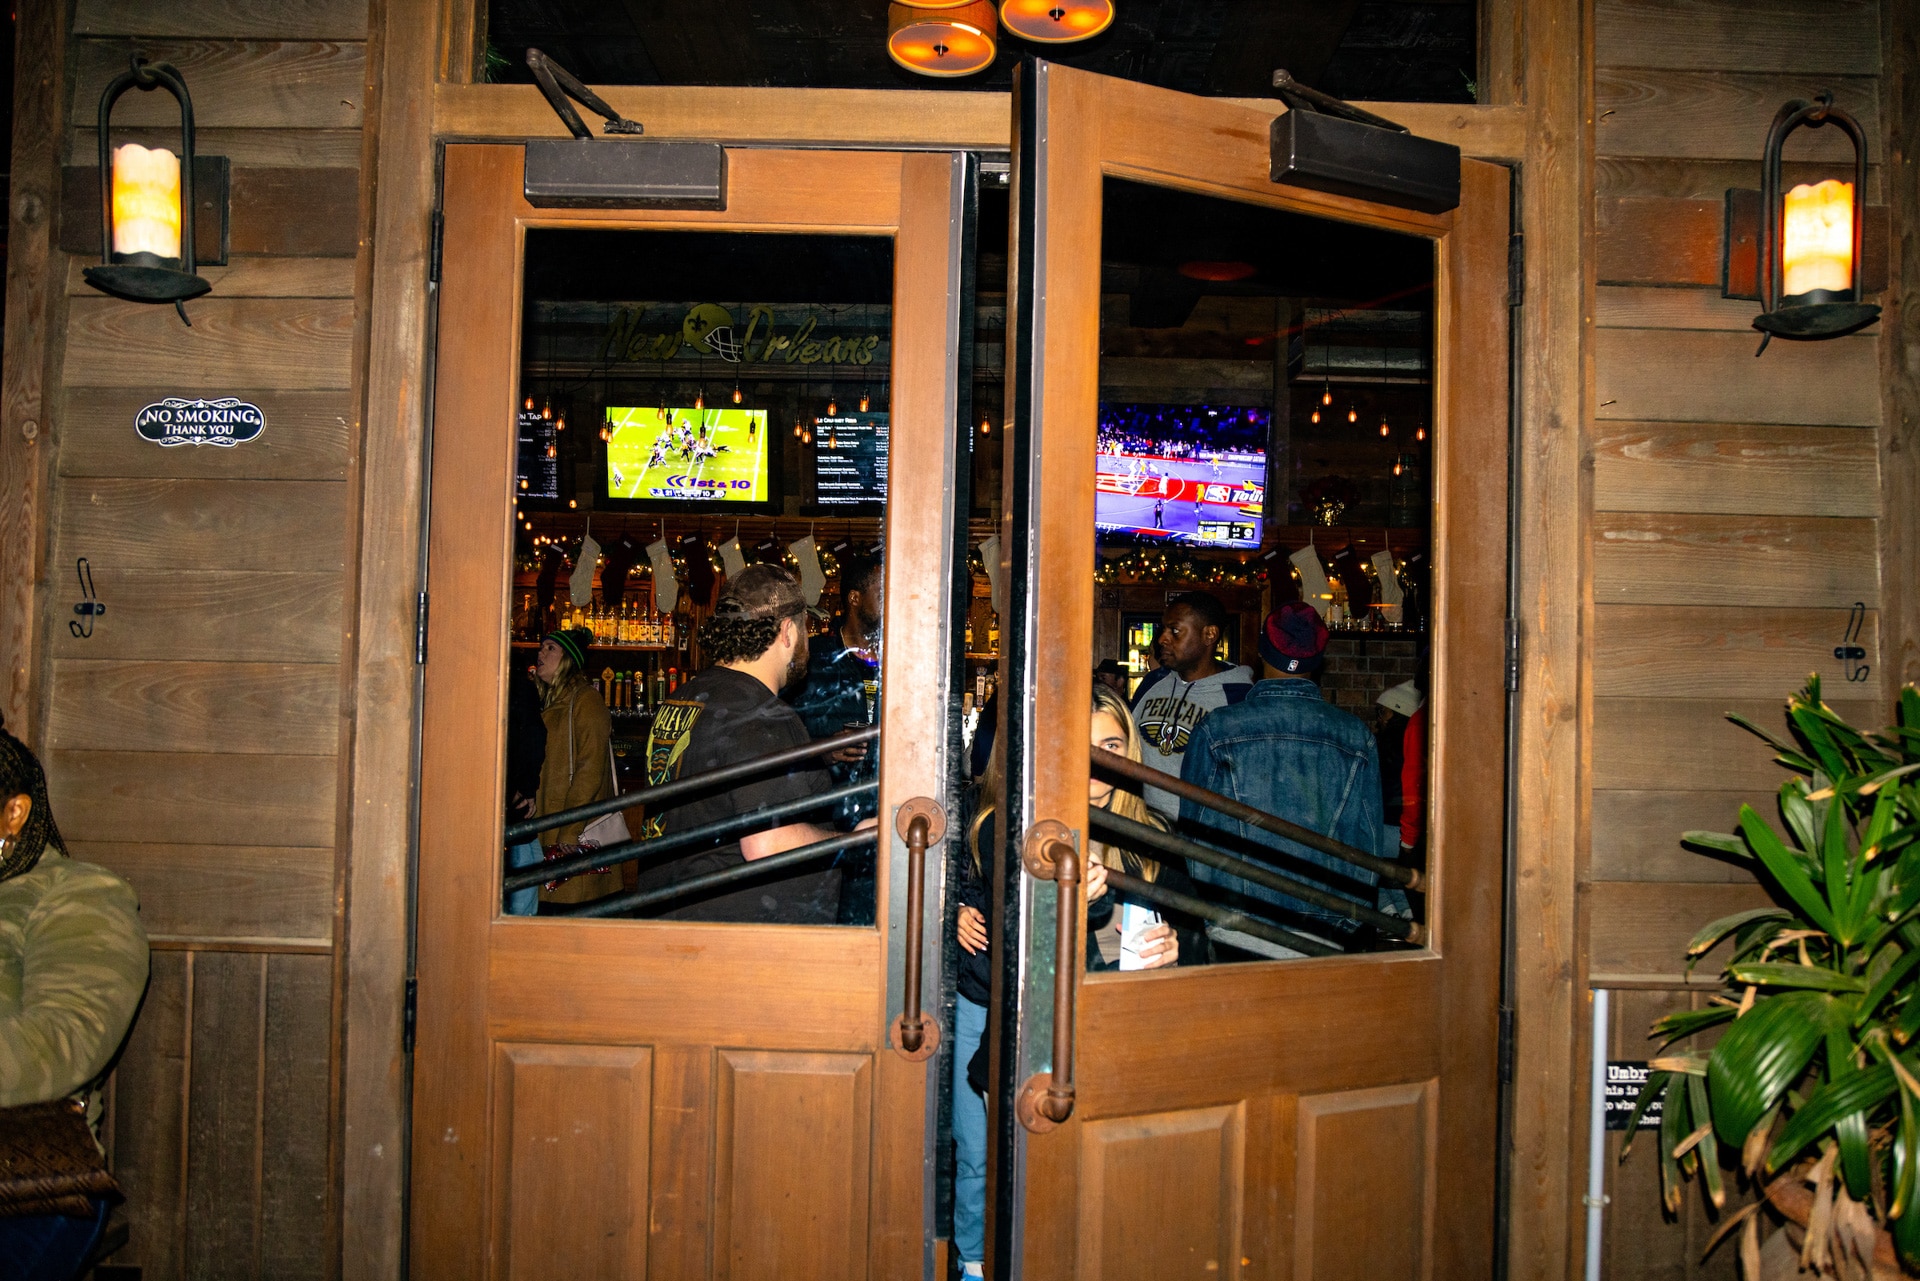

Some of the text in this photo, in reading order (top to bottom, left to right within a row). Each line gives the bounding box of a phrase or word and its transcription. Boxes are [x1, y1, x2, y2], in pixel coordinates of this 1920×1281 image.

[743, 306, 879, 365] Orleans
[146, 410, 255, 423] NO SMOKING
[164, 424, 234, 435] THANK YOU
[689, 477, 716, 487] 1st
[730, 479, 751, 489] 10
[1608, 1066, 1652, 1080] Umbr
[1605, 1085, 1625, 1096] his
[1626, 1085, 1640, 1096] is
